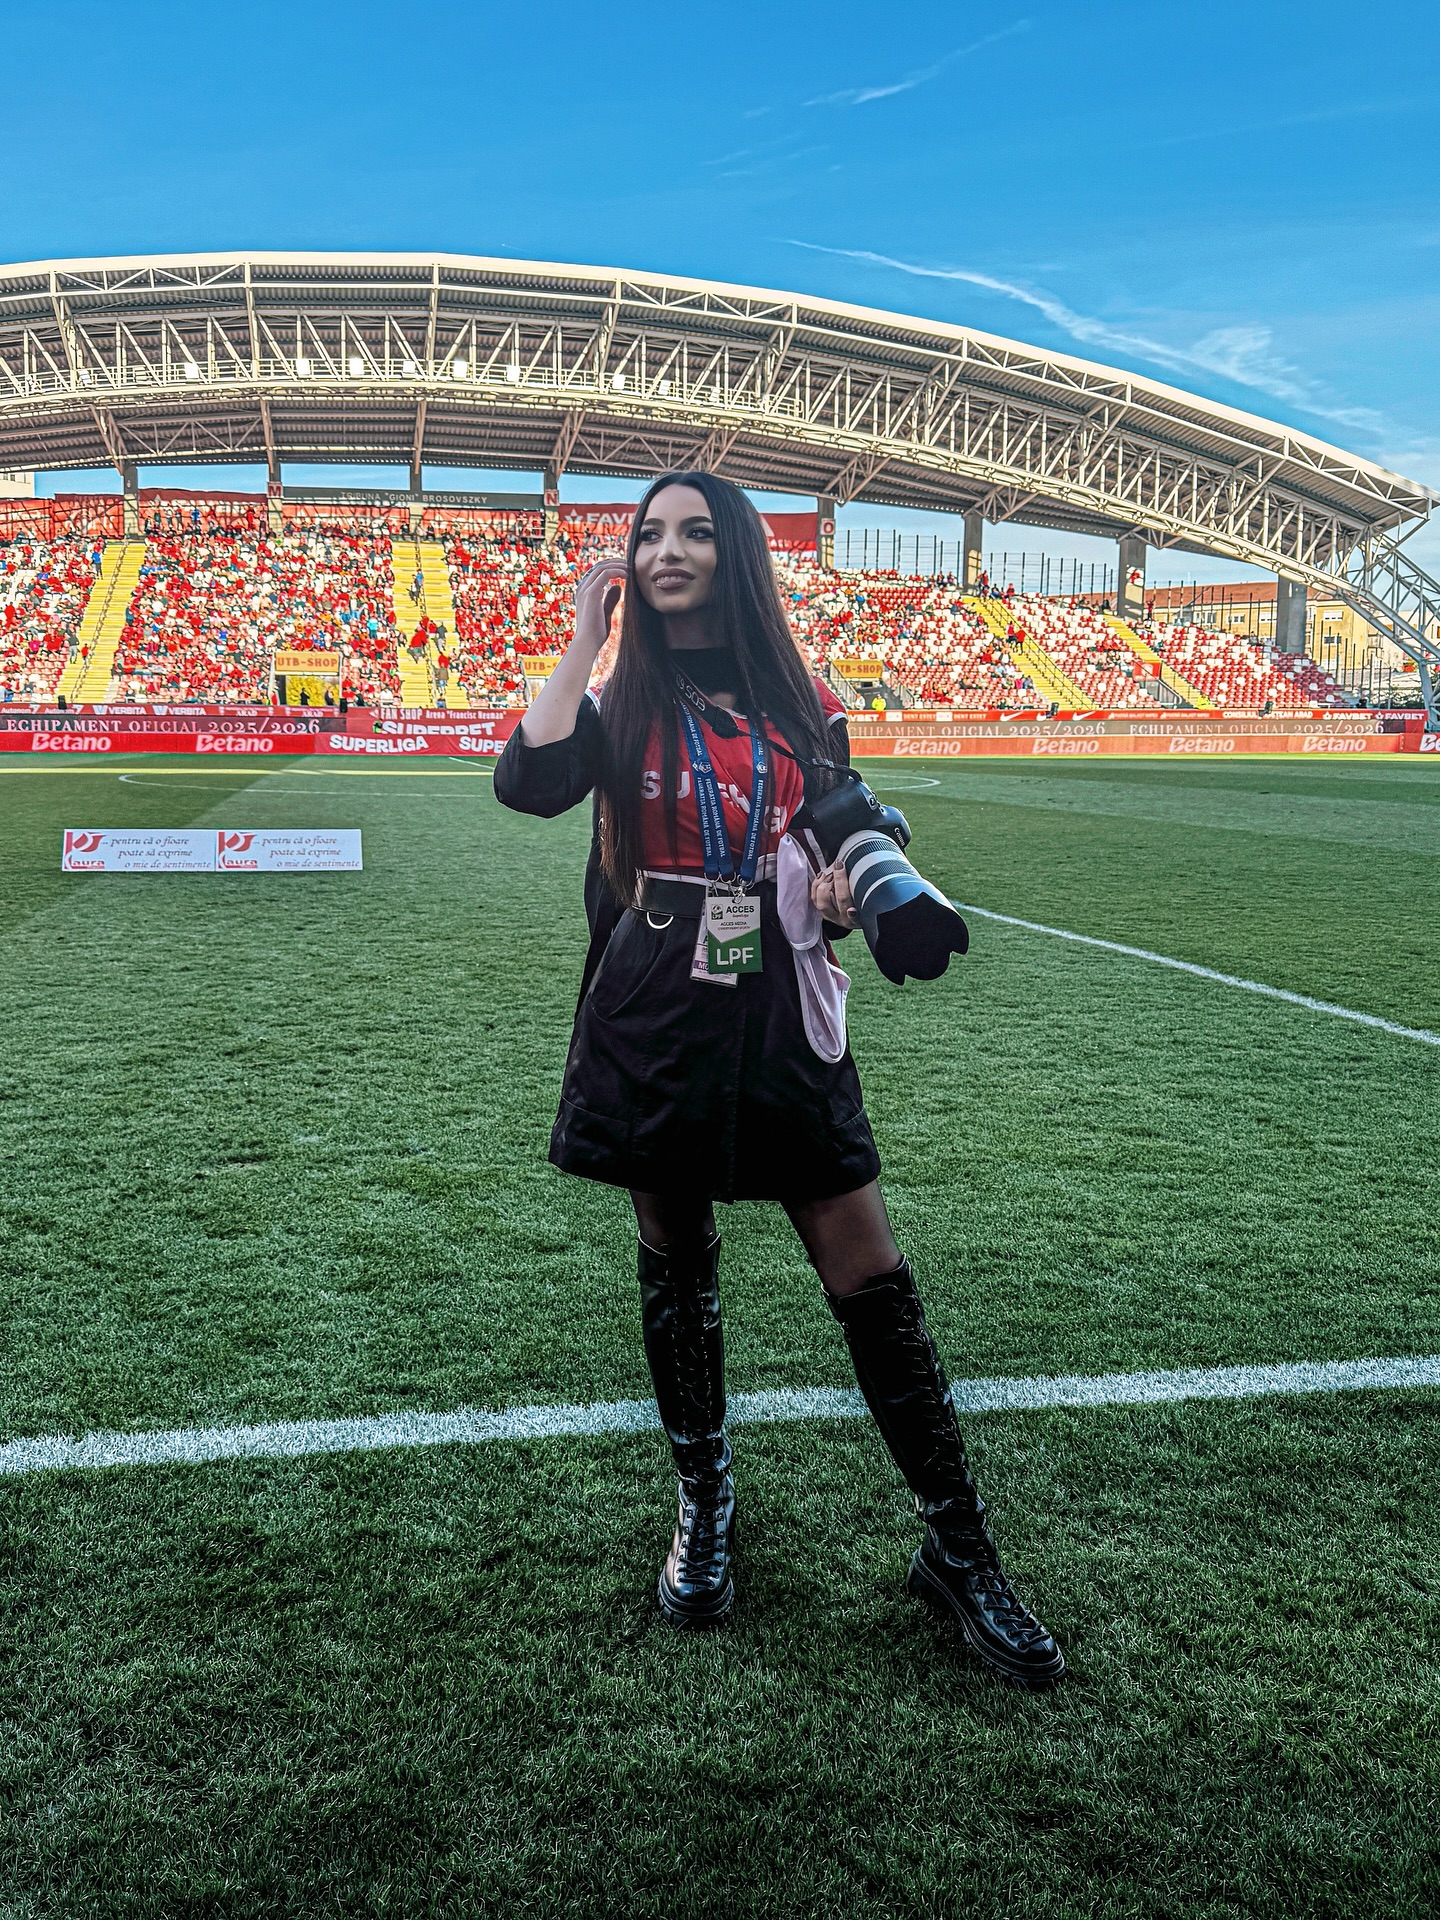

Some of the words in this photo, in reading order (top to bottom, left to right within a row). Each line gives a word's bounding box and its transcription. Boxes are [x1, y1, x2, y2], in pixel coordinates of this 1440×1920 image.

[268, 486, 281, 497] M
[341, 491, 381, 500] TRIBUNA
[422, 494, 487, 504] BROSOVSZKY
[546, 493, 557, 505] N
[277, 657, 338, 668] UTB-SHOP
[837, 665, 881, 674] TB-SHOP
[400, 709, 423, 720] SHOP
[7, 720, 122, 732] ECHIPAMENT
[128, 721, 201, 733] OFICIAL
[208, 717, 320, 734] 2025/2026
[941, 726, 1004, 736] OFICIAL
[1009, 721, 1106, 736] 2025/2026
[1130, 724, 1224, 734] ECHIPAMENT
[1229, 725, 1290, 734] OFICIAL
[1295, 720, 1384, 734] 2025/2026
[32, 733, 112, 751] Betano
[195, 734, 274, 753] Betano
[329, 734, 429, 753] SUPERLIGA
[459, 735, 508, 754] SUPE
[893, 738, 961, 755] Betano
[1032, 738, 1100, 754] Betano
[1168, 737, 1235, 753] Betano
[1302, 736, 1367, 752] Betano
[110, 838, 141, 847] pentru
[894, 827, 906, 847] Canon
[118, 850, 143, 859] poate
[157, 850, 193, 859] exprime
[162, 860, 212, 868] sentimente
[726, 905, 755, 914] ACCES
[716, 947, 754, 966] LPF
